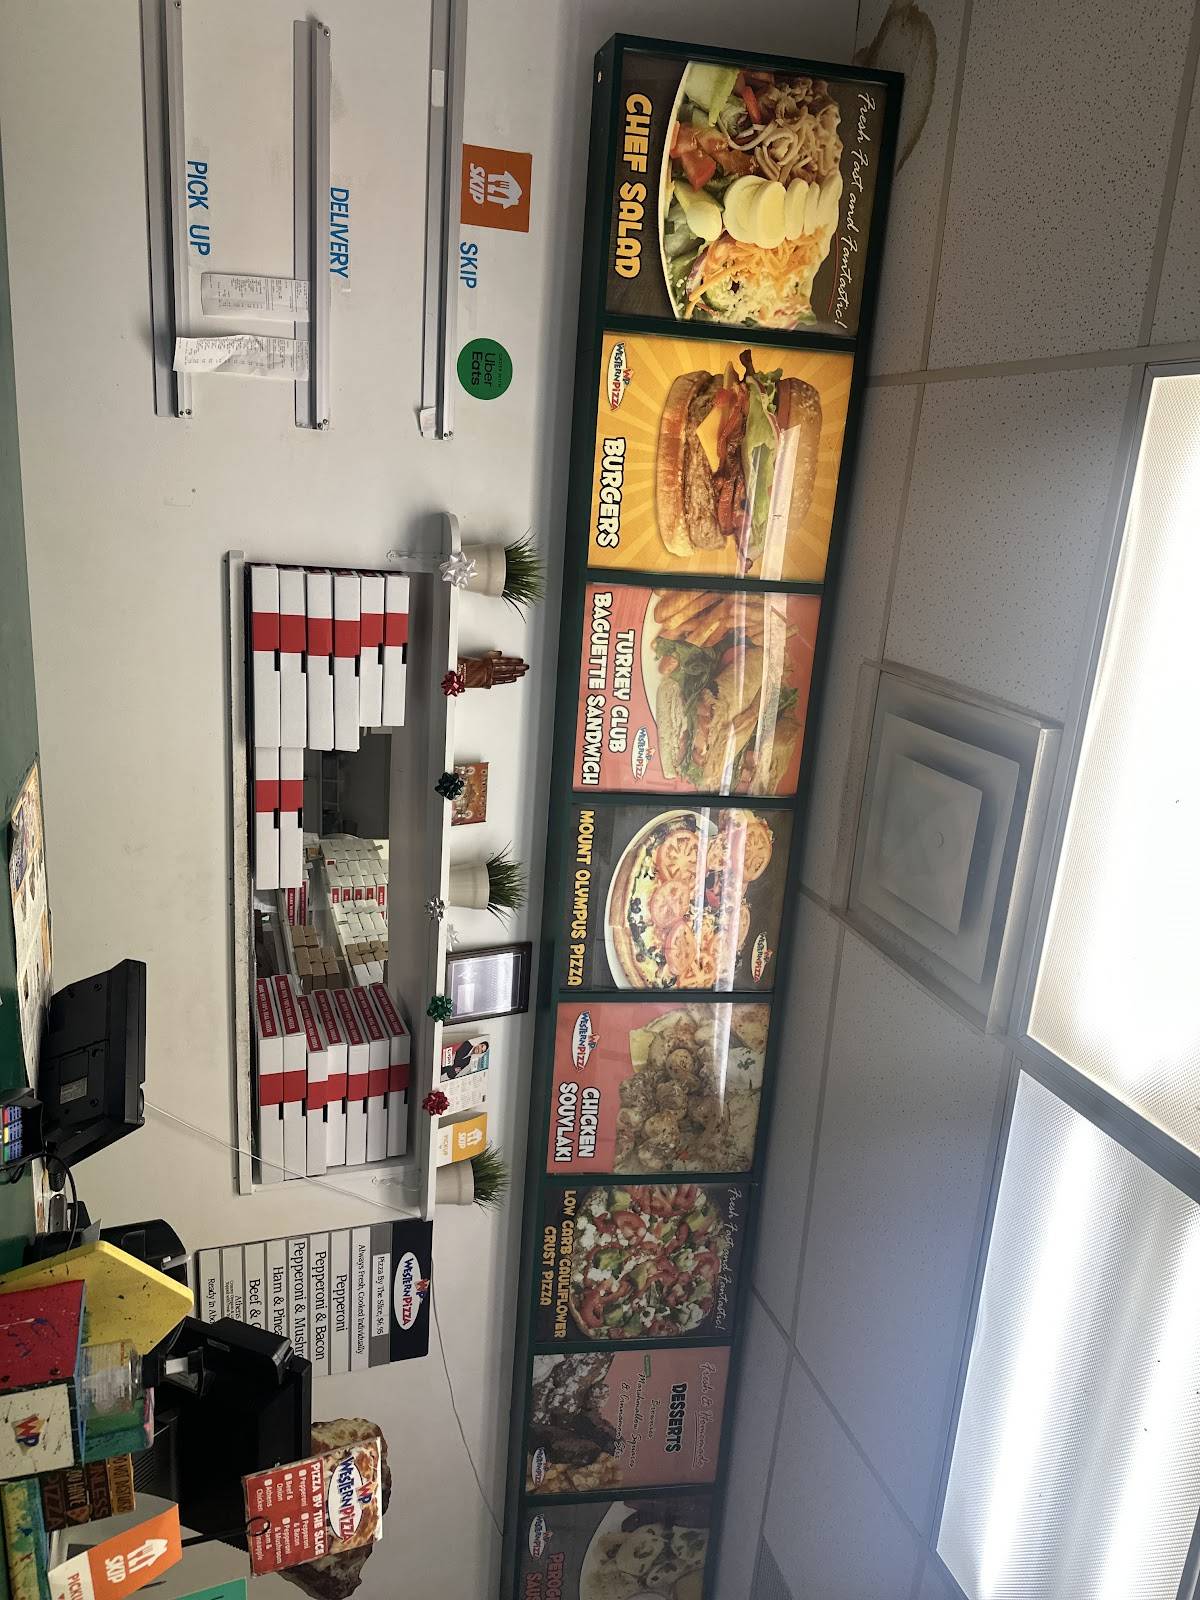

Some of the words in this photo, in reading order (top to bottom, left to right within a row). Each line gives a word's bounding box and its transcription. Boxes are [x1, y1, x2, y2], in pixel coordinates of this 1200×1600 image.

[623, 93, 652, 173] CHEF
[856, 93, 876, 143] Fresh
[187, 160, 209, 210] PICK
[469, 163, 485, 204] SKIP
[850, 149, 868, 193] Fast
[846, 193, 860, 231] and
[189, 224, 210, 256] UP
[330, 187, 350, 279] DELIVERY
[614, 181, 648, 279] SALAD
[459, 241, 478, 289] SKIP
[834, 235, 858, 329] Fantastic!
[471, 351, 484, 386] Eats
[484, 352, 496, 387] Uber
[596, 437, 626, 549] BURGERS
[588, 592, 613, 689] BAGUETTE
[612, 629, 636, 701] TURKEY
[582, 694, 606, 786] SANDWICH
[608, 705, 629, 753] CLUB
[576, 810, 595, 865] MOUNT
[570, 869, 592, 939] OLYMPUS
[566, 943, 586, 987] PIZZA
[554, 1082, 578, 1162] SOUVLAKI
[578, 1087, 600, 1158] CHICKEN
[458, 1131, 467, 1149] SKIP
[562, 1190, 576, 1216] LOW
[728, 1188, 742, 1220] Fresh
[542, 1225, 556, 1267] CRUST
[560, 1220, 574, 1256] CARB
[724, 1222, 738, 1249] Fast
[291, 1241, 306, 1300] Pepperoni
[357, 1244, 366, 1270] Always
[722, 1248, 732, 1272] and
[206, 1278, 216, 1300] Ready
[249, 1279, 262, 1306] Beef
[273, 1266, 284, 1293] Ham
[312, 1251, 326, 1309] Pepperoni
[356, 1271, 366, 1291] Fresh,
[376, 1275, 384, 1285] By
[414, 1278, 430, 1298] WP
[540, 1270, 554, 1306] PIZZA
[208, 1300, 216, 1308] in
[250, 1309, 260, 1319] &
[274, 1296, 284, 1307] &
[294, 1303, 305, 1314] &
[333, 1274, 348, 1332] Pepperoni
[358, 1292, 366, 1317] Cooked
[376, 1299, 384, 1317] Slice,
[554, 1258, 571, 1339] CAULIFLOWER
[714, 1274, 732, 1330] Fantastic!
[316, 1312, 326, 1323] &
[376, 1317, 384, 1335] $6.95
[316, 1325, 326, 1361] Bacon
[356, 1318, 365, 1355] Individually
[700, 1362, 716, 1392] Fresh
[633, 1373, 646, 1430] Marshmallow
[13, 1414, 41, 1448] WP
[664, 1383, 688, 1454] DESSERTS
[696, 1411, 713, 1468] Homemade
[276, 1483, 284, 1502] Onion
[286, 1480, 294, 1494] Beef
[298, 1477, 308, 1507] Pepperoni
[310, 1462, 322, 1493] PIZZA
[357, 1482, 374, 1505] WP
[116, 1480, 132, 1513] DISTURB
[256, 1488, 264, 1512] Chicken
[265, 1486, 273, 1508] Athens
[312, 1494, 322, 1508] BY
[300, 1520, 310, 1550] Pepperoni
[313, 1510, 323, 1529] THE
[274, 1533, 283, 1565] Mushroom
[282, 1524, 292, 1555] Pepperoni
[314, 1531, 324, 1556] SLICE
[104, 1555, 126, 1584] SKIP
